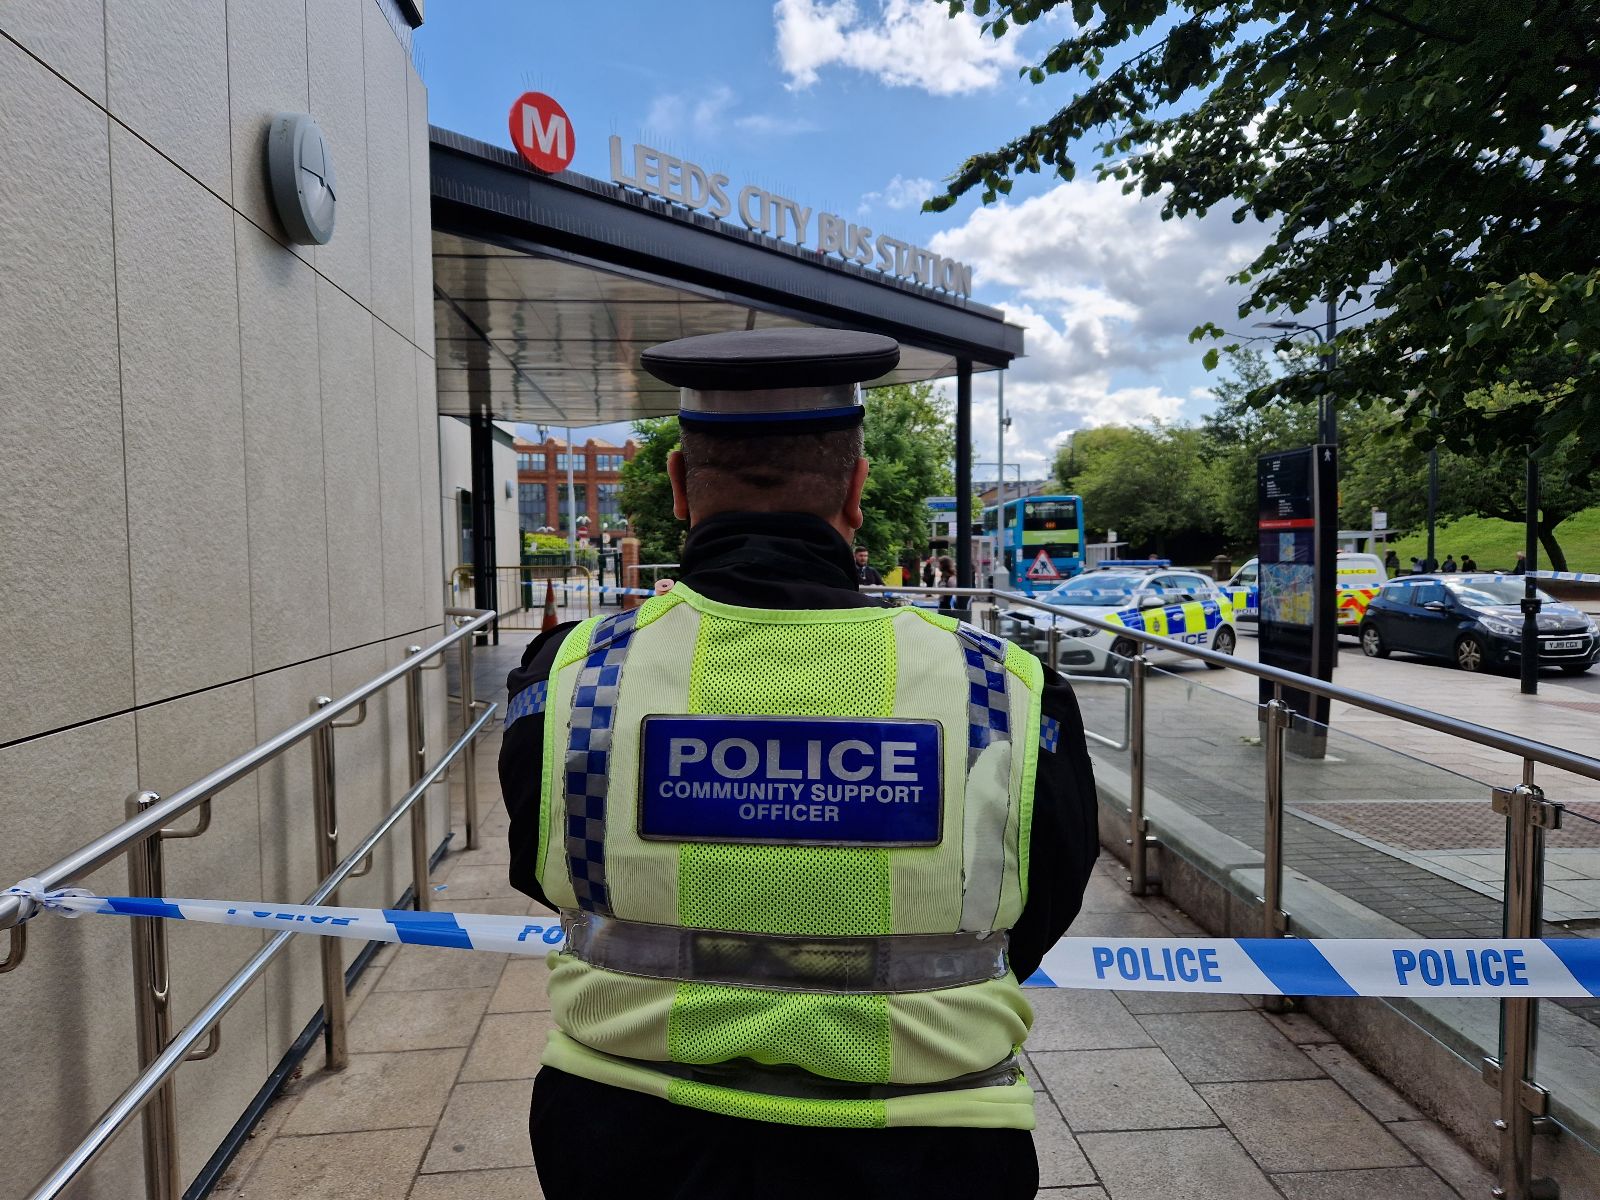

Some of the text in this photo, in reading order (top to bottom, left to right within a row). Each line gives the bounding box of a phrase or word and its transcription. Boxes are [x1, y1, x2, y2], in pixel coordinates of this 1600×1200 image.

[522, 103, 567, 160] M
[609, 135, 973, 299] LEEDS CITY BUS STATION
[668, 737, 919, 782] POLICE
[659, 781, 923, 803] COMMUNITY SUPPORT
[738, 803, 840, 822] OFFICER
[1092, 946, 1530, 987] POLICE POLICE
